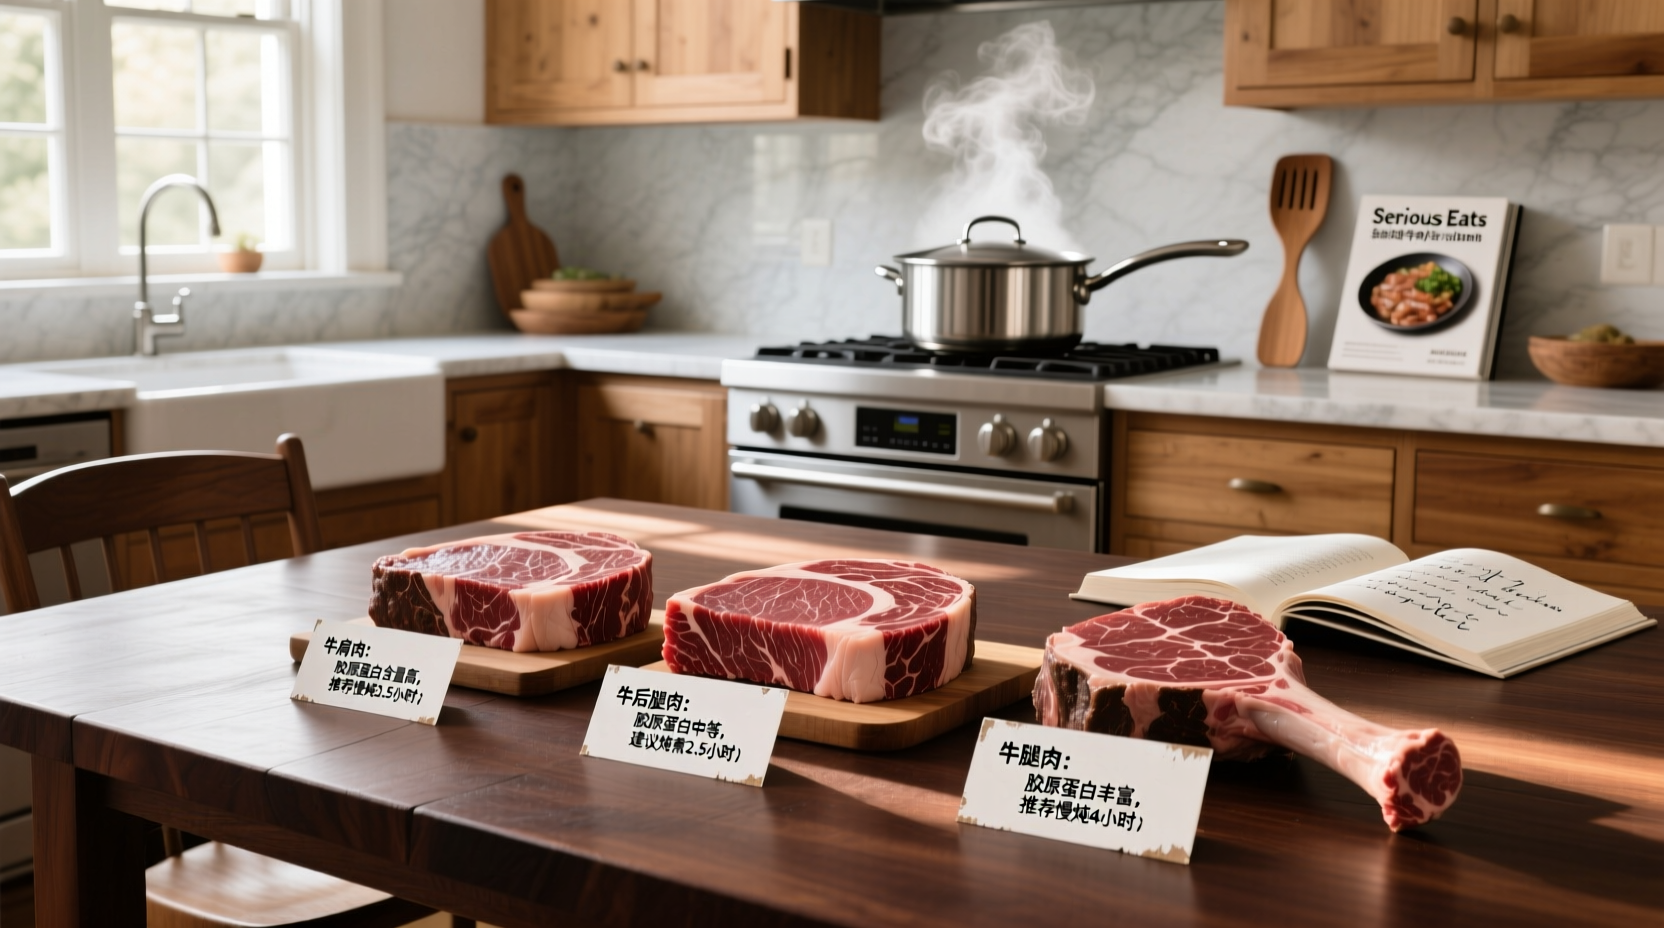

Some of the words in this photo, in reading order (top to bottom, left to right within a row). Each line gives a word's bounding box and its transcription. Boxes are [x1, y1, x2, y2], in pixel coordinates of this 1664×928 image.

[1372, 207, 1443, 227] Serious
[1446, 209, 1488, 228] Eats
[616, 685, 690, 711] 牛后腿肉：
[998, 740, 1071, 770] 牛腿肉：
[1023, 773, 1141, 809] 胶原蛋白丰富，
